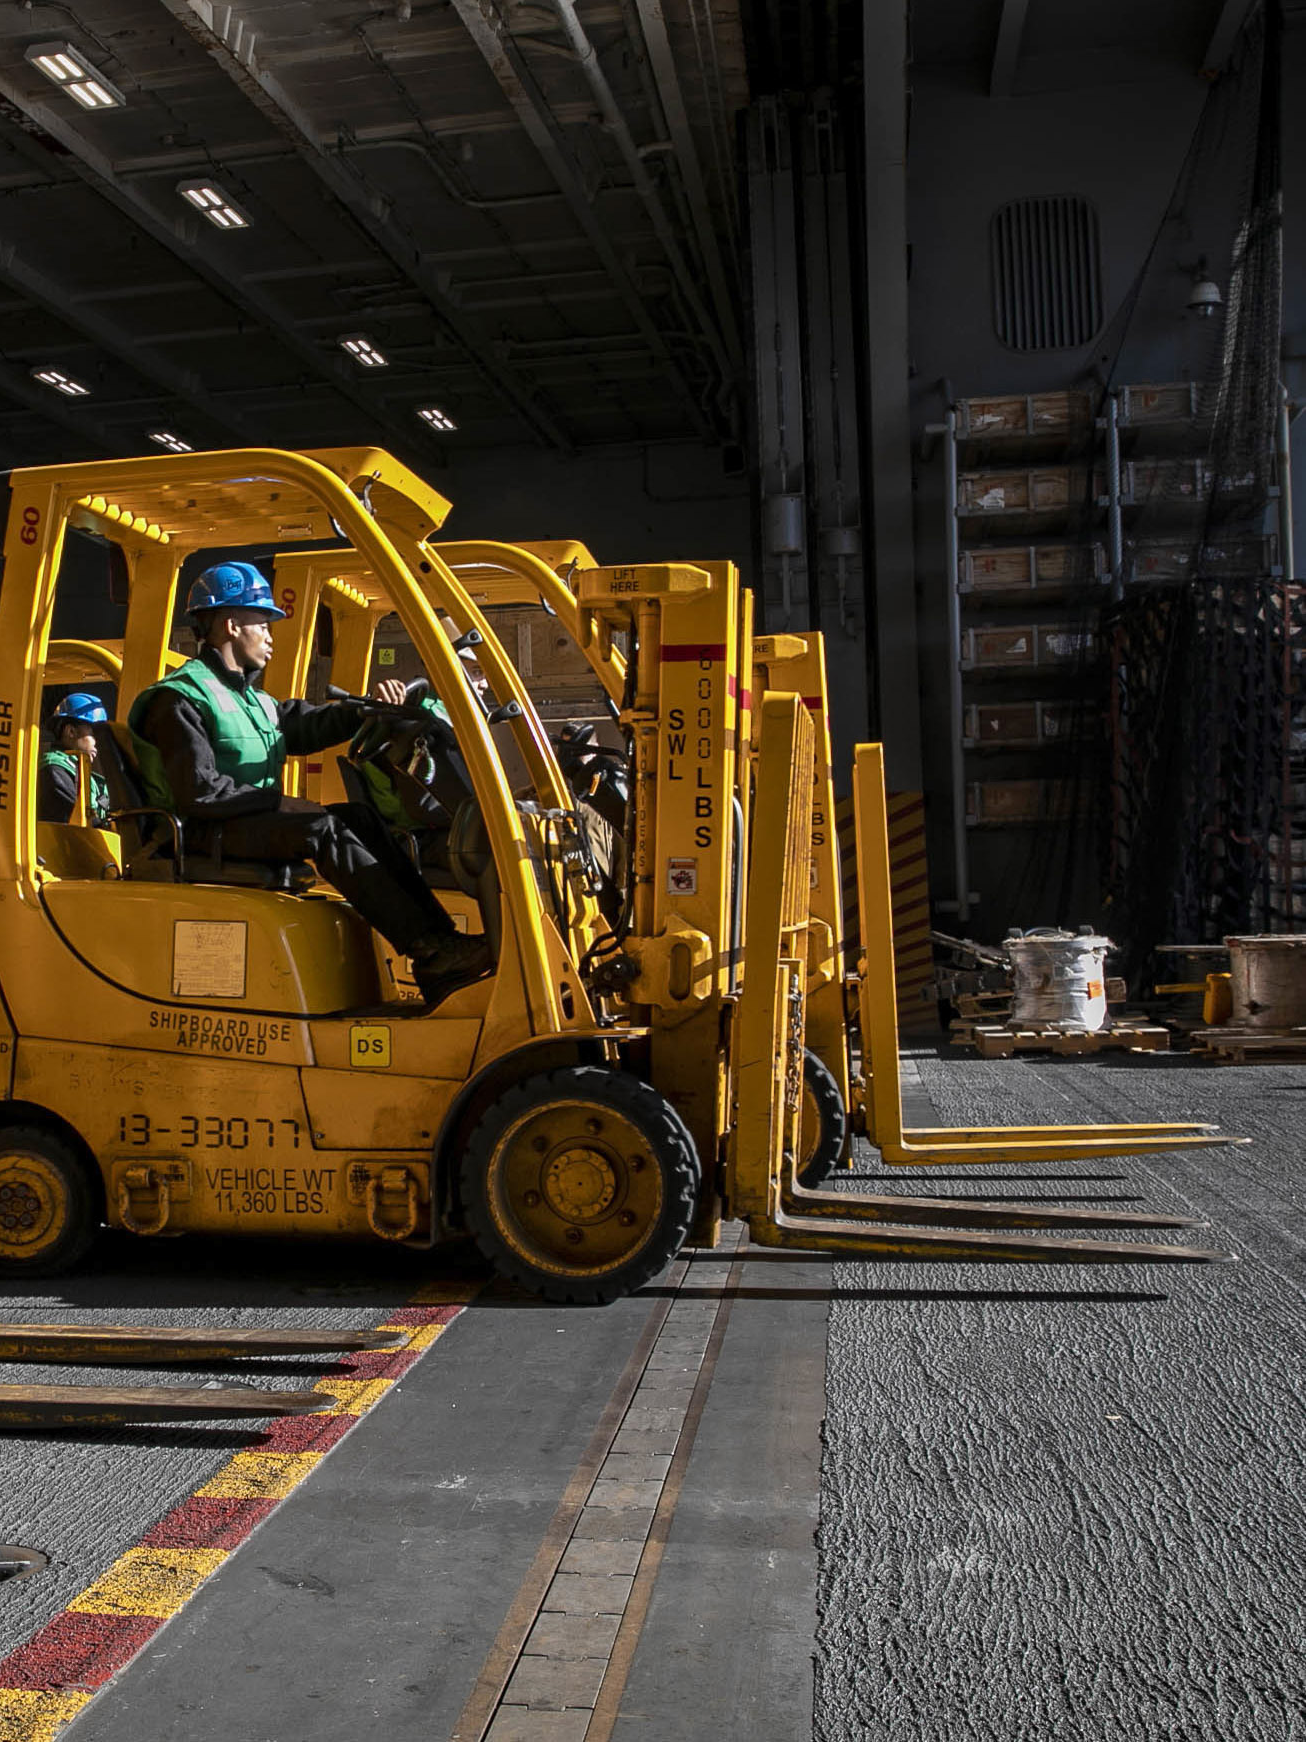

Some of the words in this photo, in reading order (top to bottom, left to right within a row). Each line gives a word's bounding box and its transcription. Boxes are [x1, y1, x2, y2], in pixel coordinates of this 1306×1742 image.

[20, 507, 40, 545] 60
[614, 568, 636, 579] LIFT
[610, 581, 638, 593] HERE
[668, 709, 686, 781] SWL
[150, 1010, 248, 1038] SHIPBOARD
[256, 1022, 292, 1042] USE
[176, 1031, 268, 1056] APPROVED
[356, 1038, 384, 1054] DS
[120, 1113, 300, 1149] 13-33077
[205, 1168, 297, 1191] VEHICLE
[303, 1169, 337, 1191] WT
[214, 1191, 277, 1215] 11,360
[283, 1192, 330, 1214] LBS.
